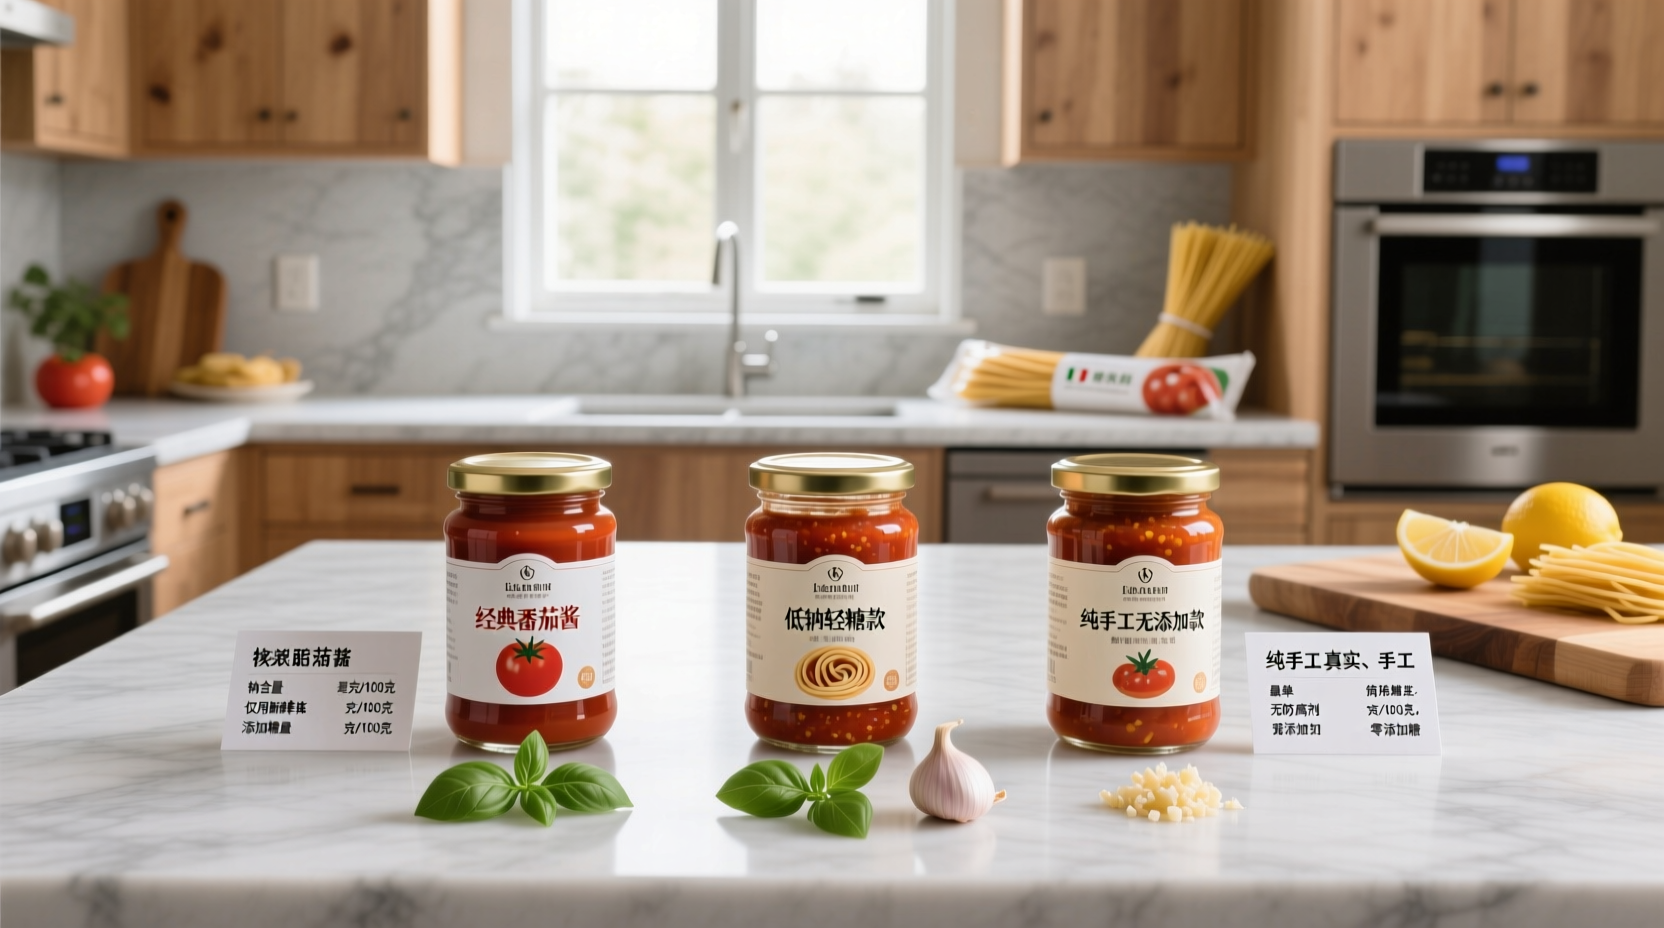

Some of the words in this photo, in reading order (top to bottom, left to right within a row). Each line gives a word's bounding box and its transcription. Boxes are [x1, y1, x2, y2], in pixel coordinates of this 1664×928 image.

[475, 604, 580, 631] 经典番茄酱
[1080, 607, 1205, 632] 纯手工无添加款
